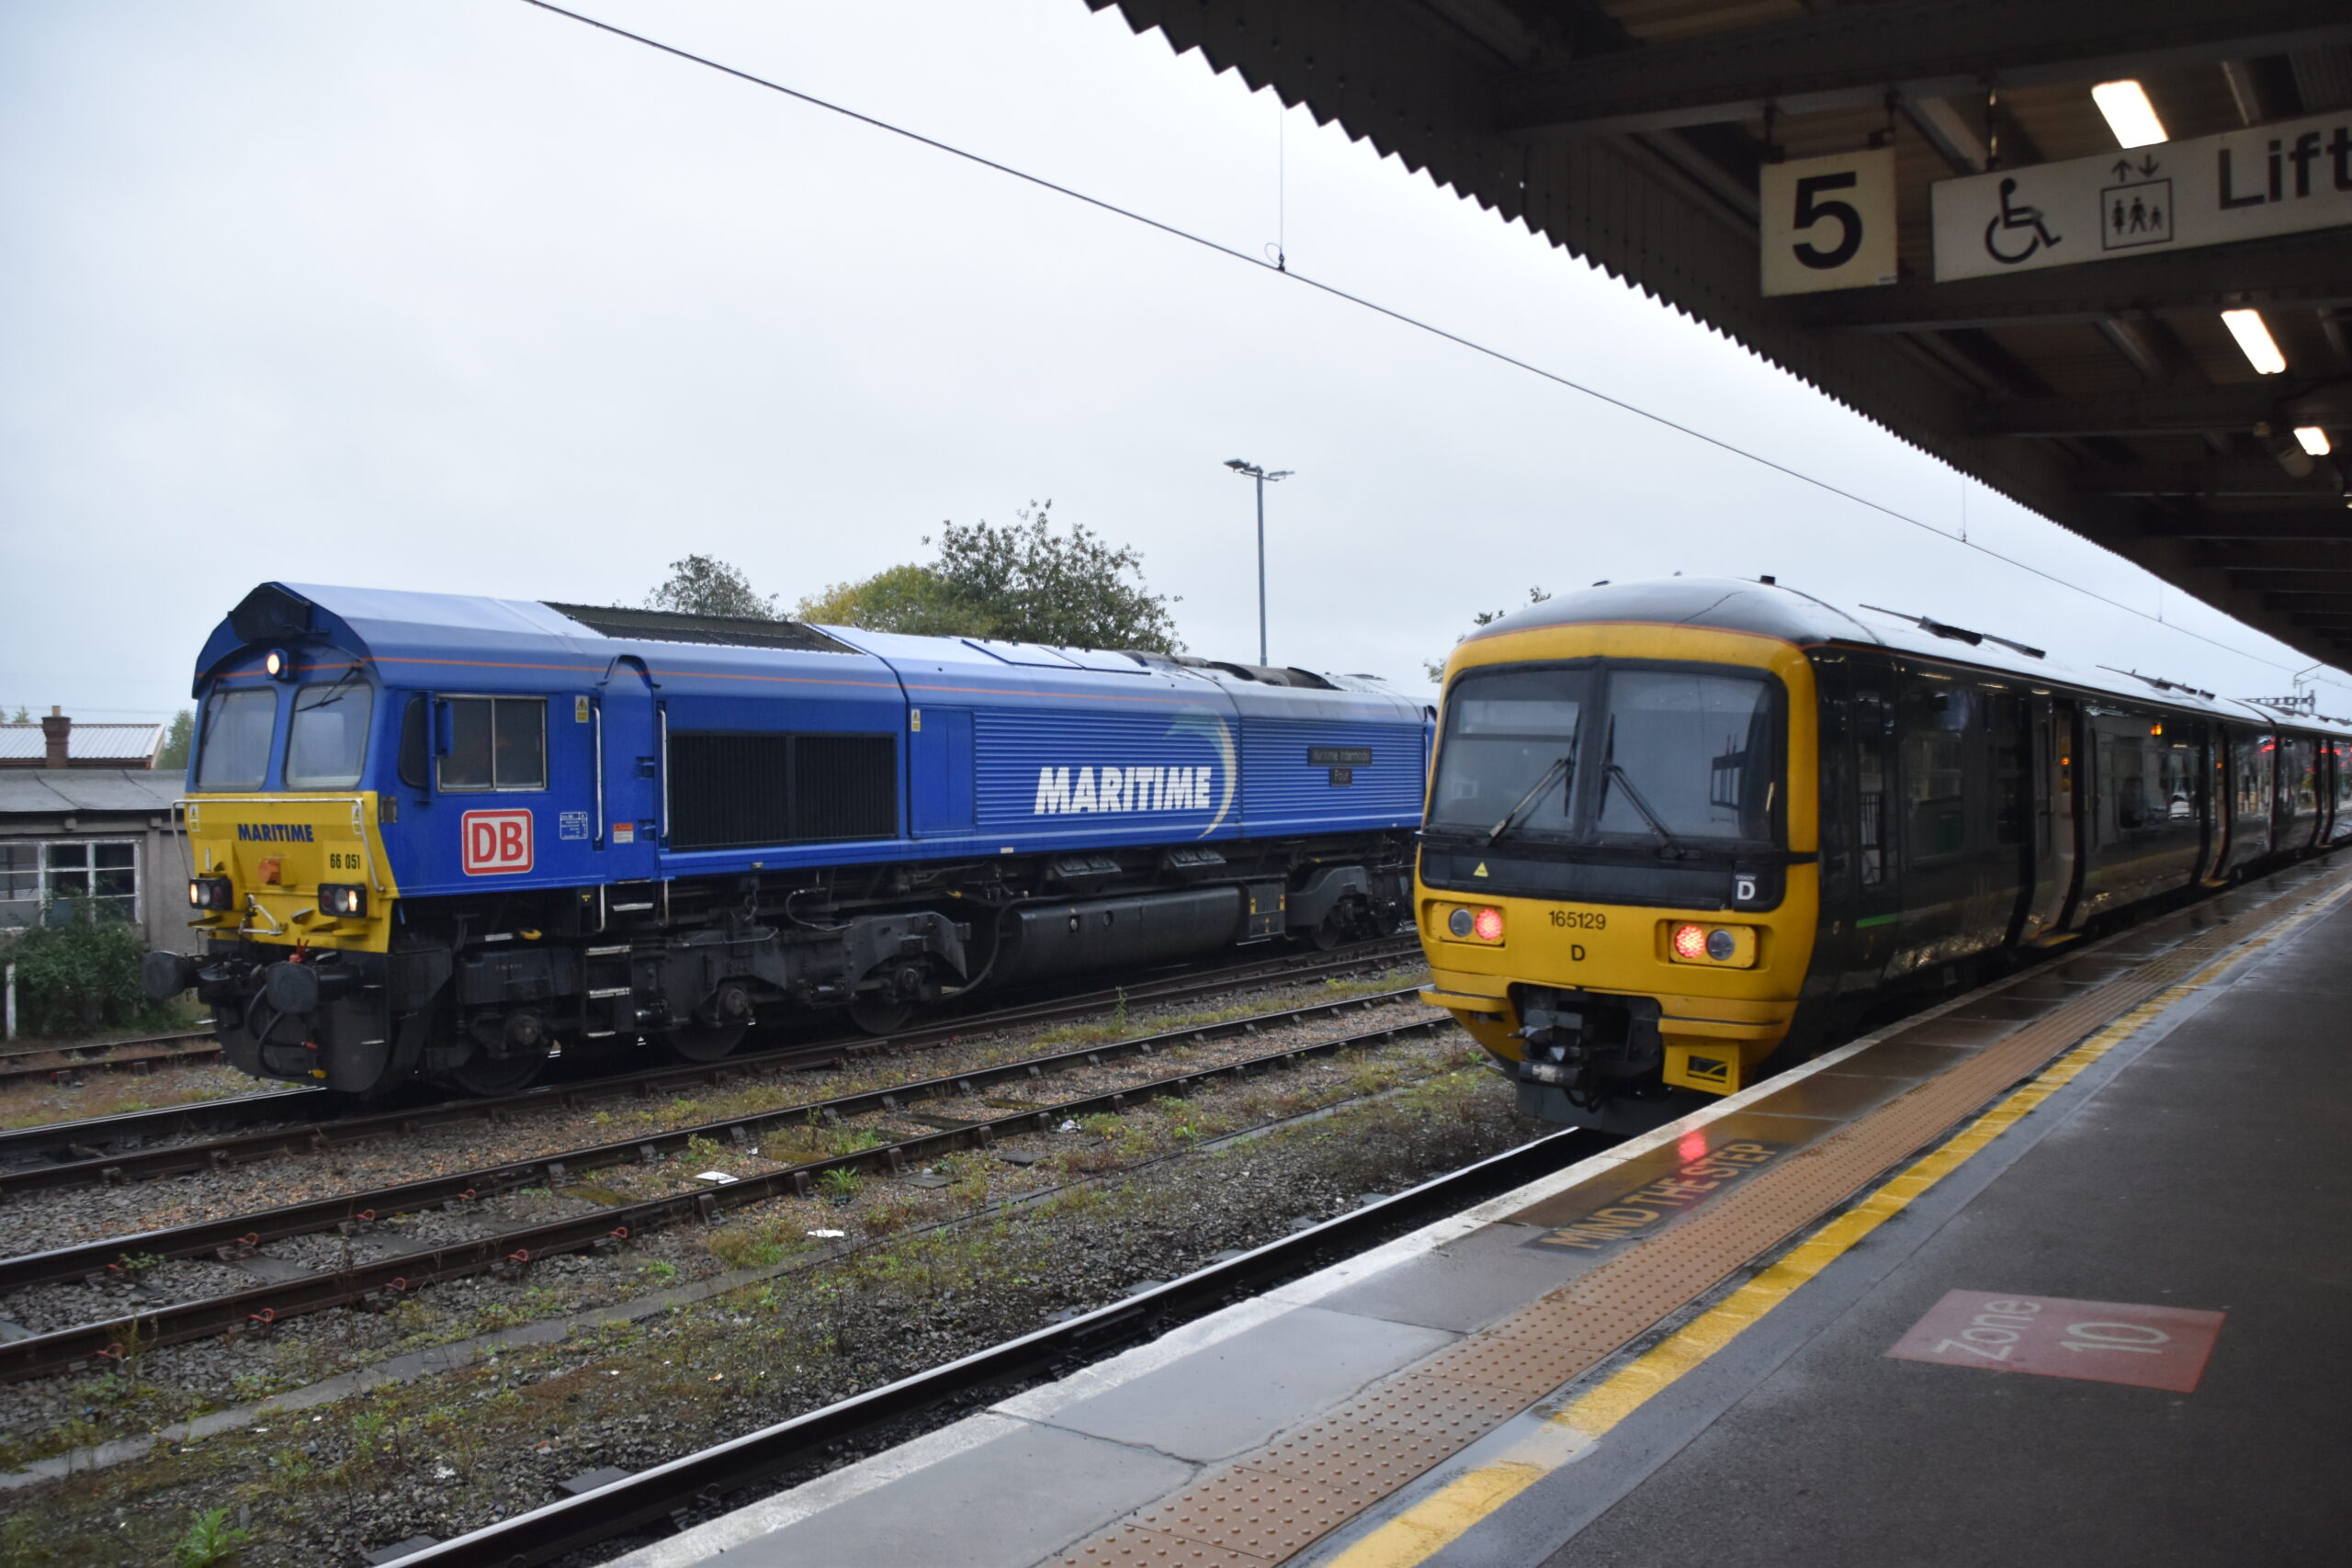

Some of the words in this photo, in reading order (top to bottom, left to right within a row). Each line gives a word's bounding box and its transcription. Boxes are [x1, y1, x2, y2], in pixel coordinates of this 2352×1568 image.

[2218, 128, 2352, 210] Lift
[1792, 171, 1863, 270] 5
[1034, 766, 1212, 815] MARITIME
[237, 823, 313, 842] MARITIME
[472, 821, 524, 863] DB
[330, 853, 341, 869] 66
[345, 854, 360, 870] 051
[1737, 881, 1756, 900] D
[1548, 911, 1606, 931] 165129
[1571, 944, 1586, 961] D
[1540, 1207, 1661, 1250] MIND
[1619, 1177, 1721, 1207] THE
[1680, 1143, 1778, 1179] STEP
[1931, 1300, 2041, 1361] Zone
[2059, 1321, 2171, 1355] 10
